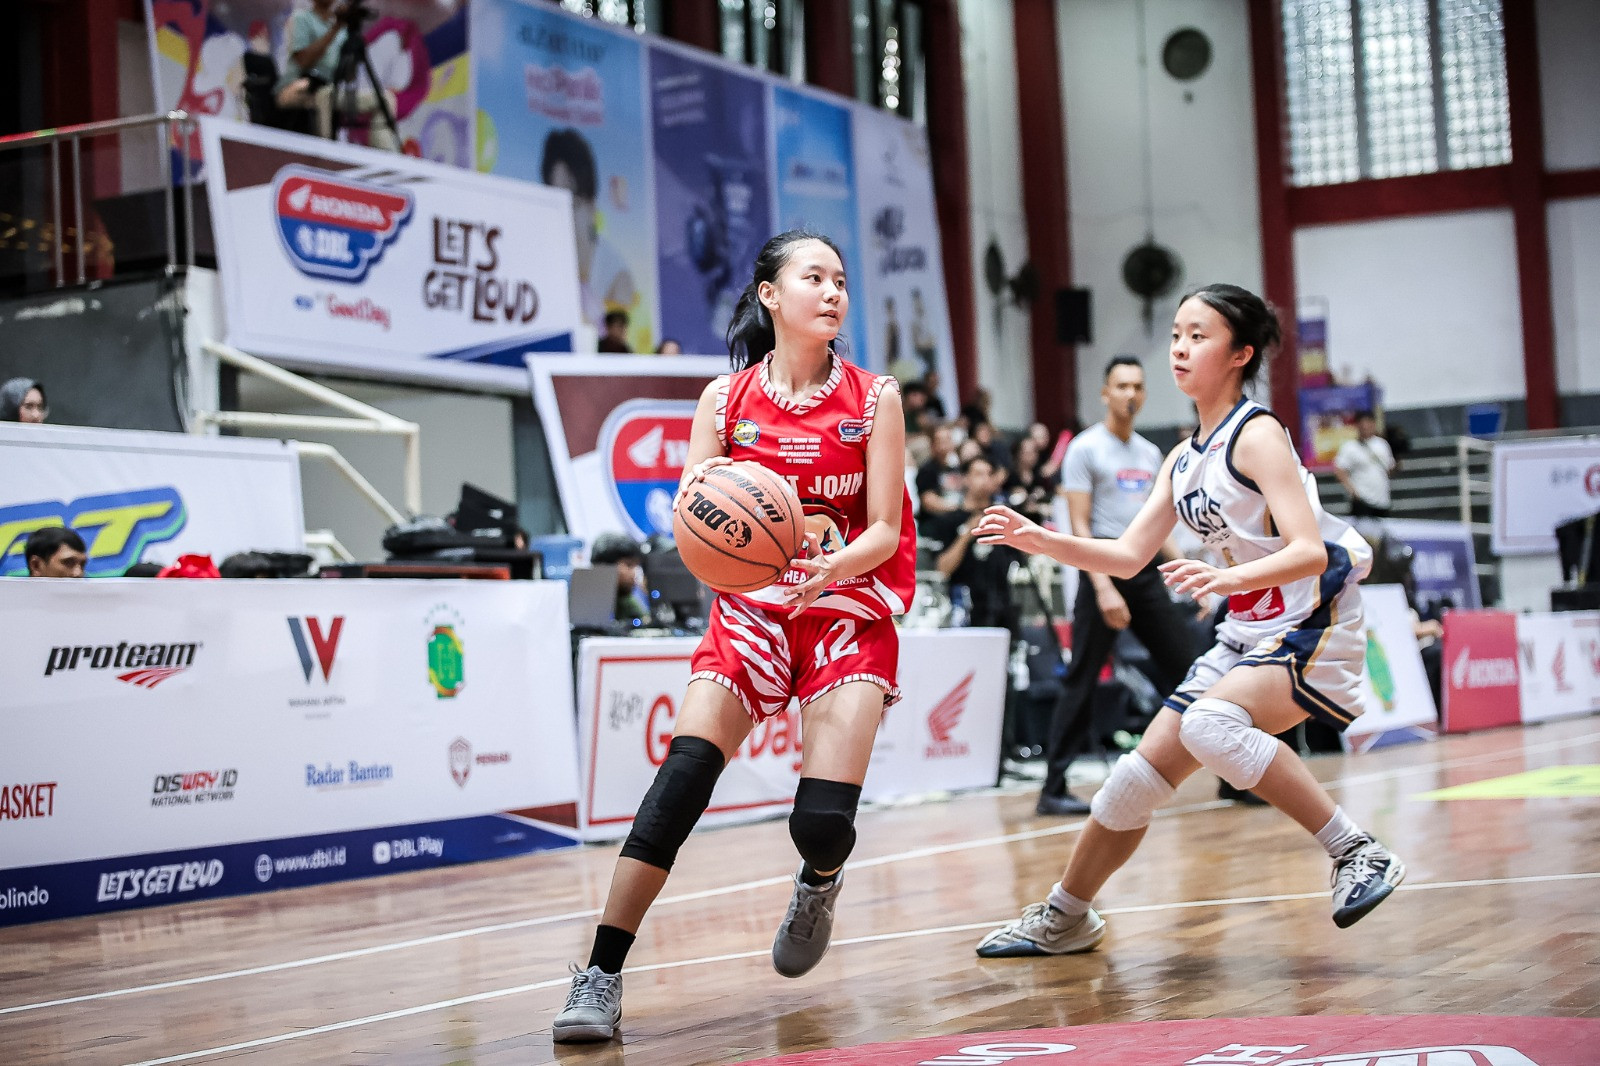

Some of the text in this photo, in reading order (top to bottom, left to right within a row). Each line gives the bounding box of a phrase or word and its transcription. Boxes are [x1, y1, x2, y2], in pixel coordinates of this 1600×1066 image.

[310, 193, 386, 226] HONDA
[432, 216, 502, 272] LET'S
[422, 270, 541, 324] GET LOUD
[686, 490, 732, 531] DBL
[837, 577, 869, 587] HONDA
[44, 641, 197, 676] proteam
[814, 618, 860, 670] 12
[305, 763, 344, 787] Radar
[348, 760, 393, 783] Banten
[0, 781, 58, 821] ASKET
[97, 858, 225, 902] LET'S GET LOUD
